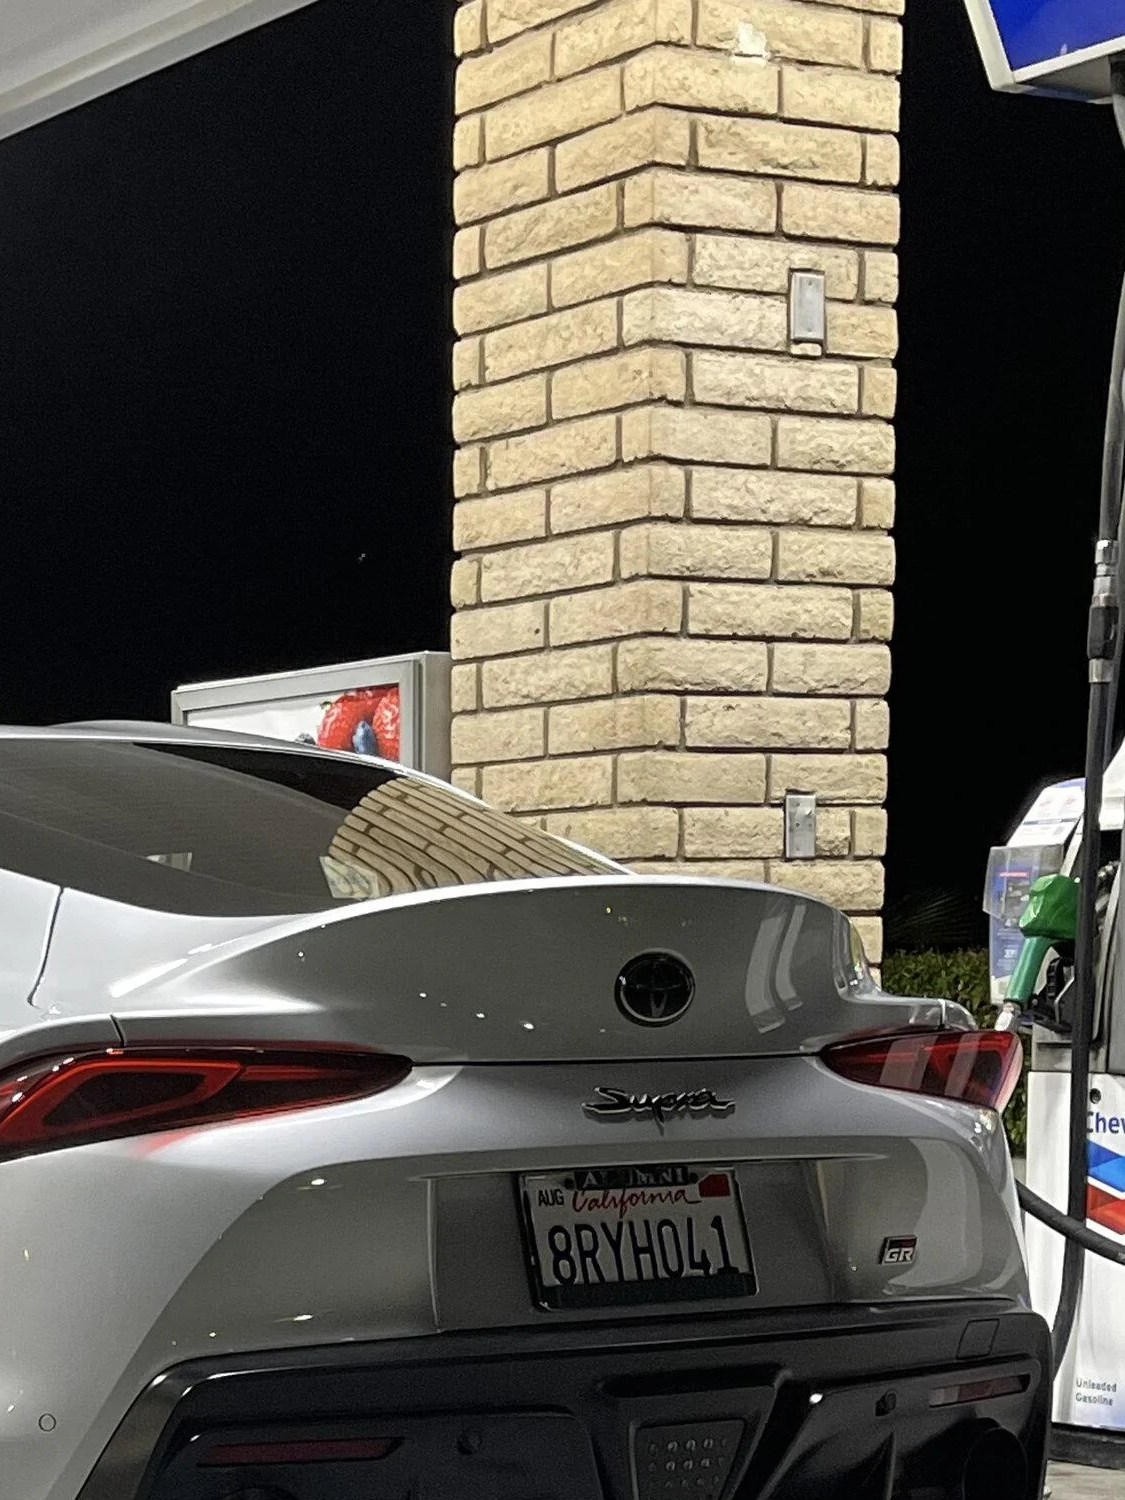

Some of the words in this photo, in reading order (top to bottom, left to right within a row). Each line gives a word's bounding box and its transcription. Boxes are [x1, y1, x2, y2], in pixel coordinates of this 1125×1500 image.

[581, 1087, 736, 1132] Supra
[582, 1167, 685, 1189] AMNI
[538, 1189, 565, 1206] AUG
[573, 1188, 701, 1218] California
[548, 1215, 740, 1287] 8RYH041
[885, 1247, 914, 1262] GR
[1076, 1378, 1117, 1392] Unleaded
[1076, 1392, 1113, 1406] Gasoline
